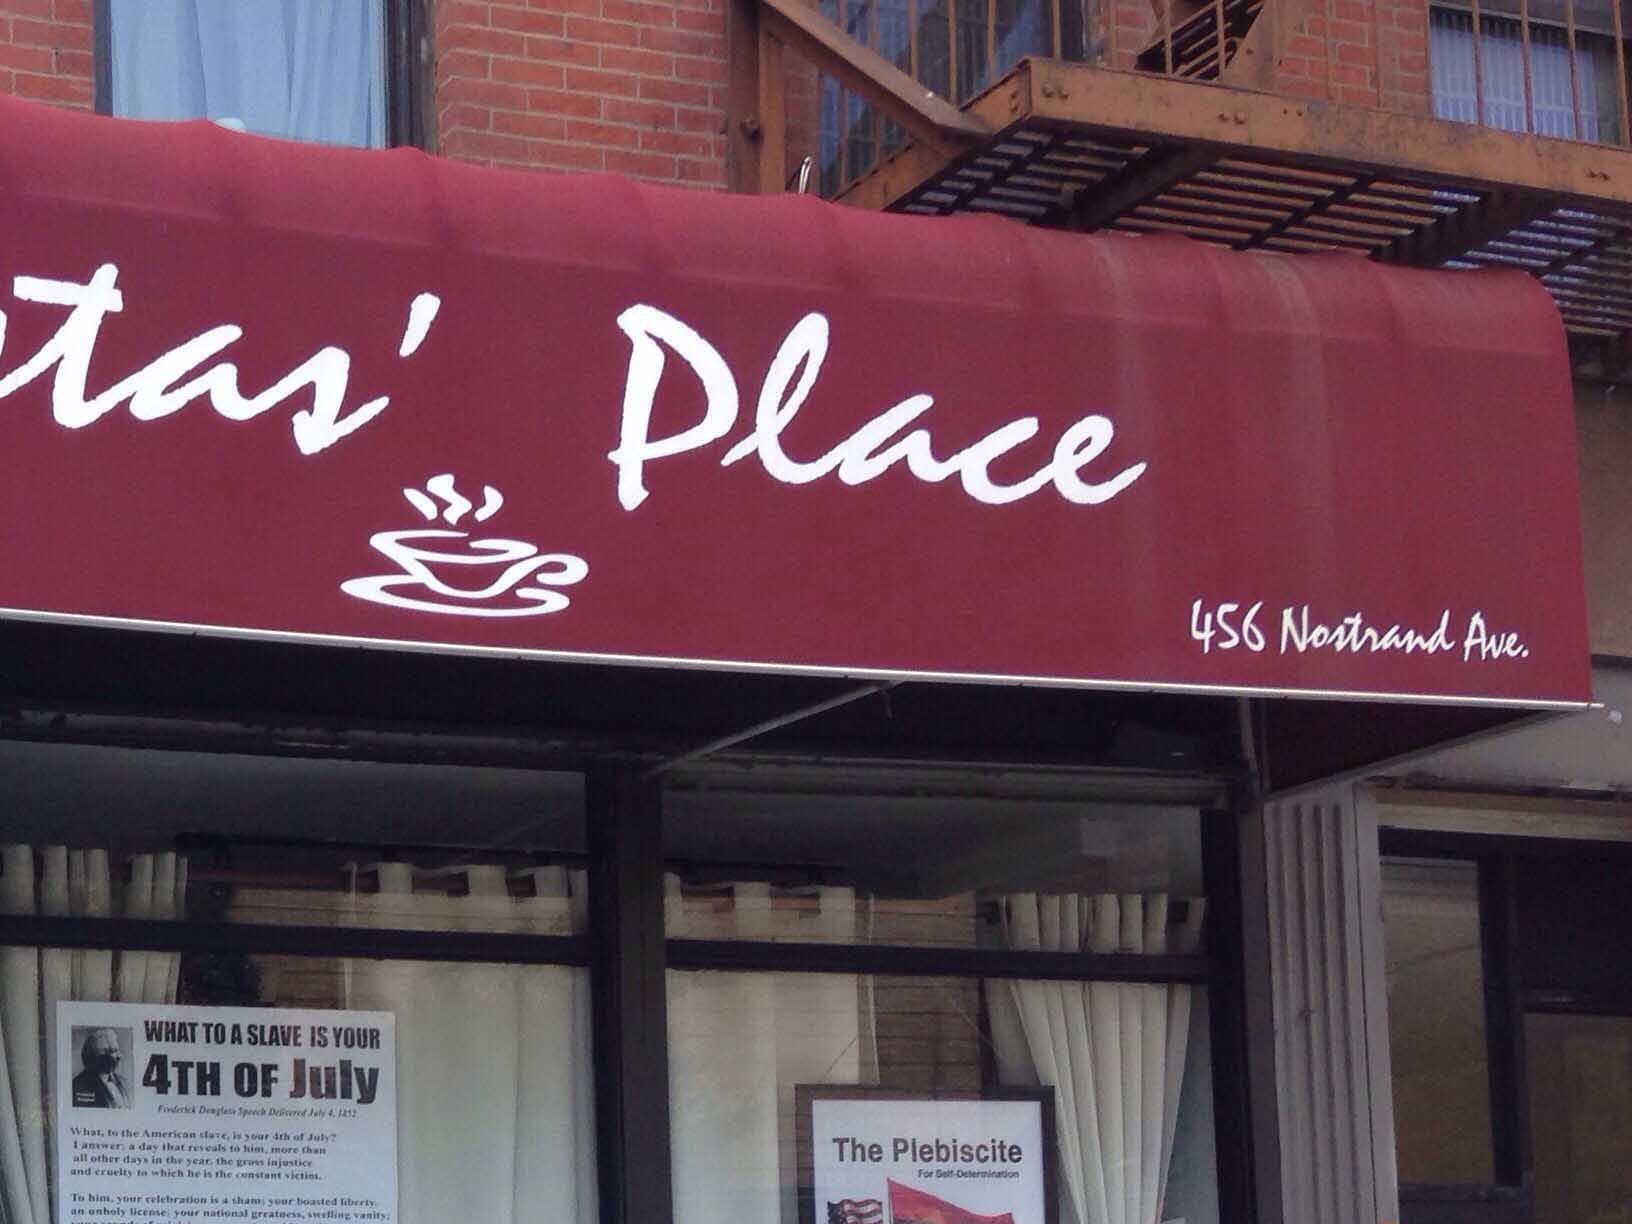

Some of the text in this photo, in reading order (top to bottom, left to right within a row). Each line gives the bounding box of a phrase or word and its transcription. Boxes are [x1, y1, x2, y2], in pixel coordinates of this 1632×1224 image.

[606, 303, 1149, 512] Place
[1191, 599, 1530, 662] 456 Nostrand Ave.
[144, 1020, 381, 1049] WHAT TO A SLAVE IS YOUR
[143, 1054, 380, 1104] 4TH OF July
[832, 1138, 1023, 1163] The Plebiscite
[918, 1169, 1020, 1179] For Self-Determination
